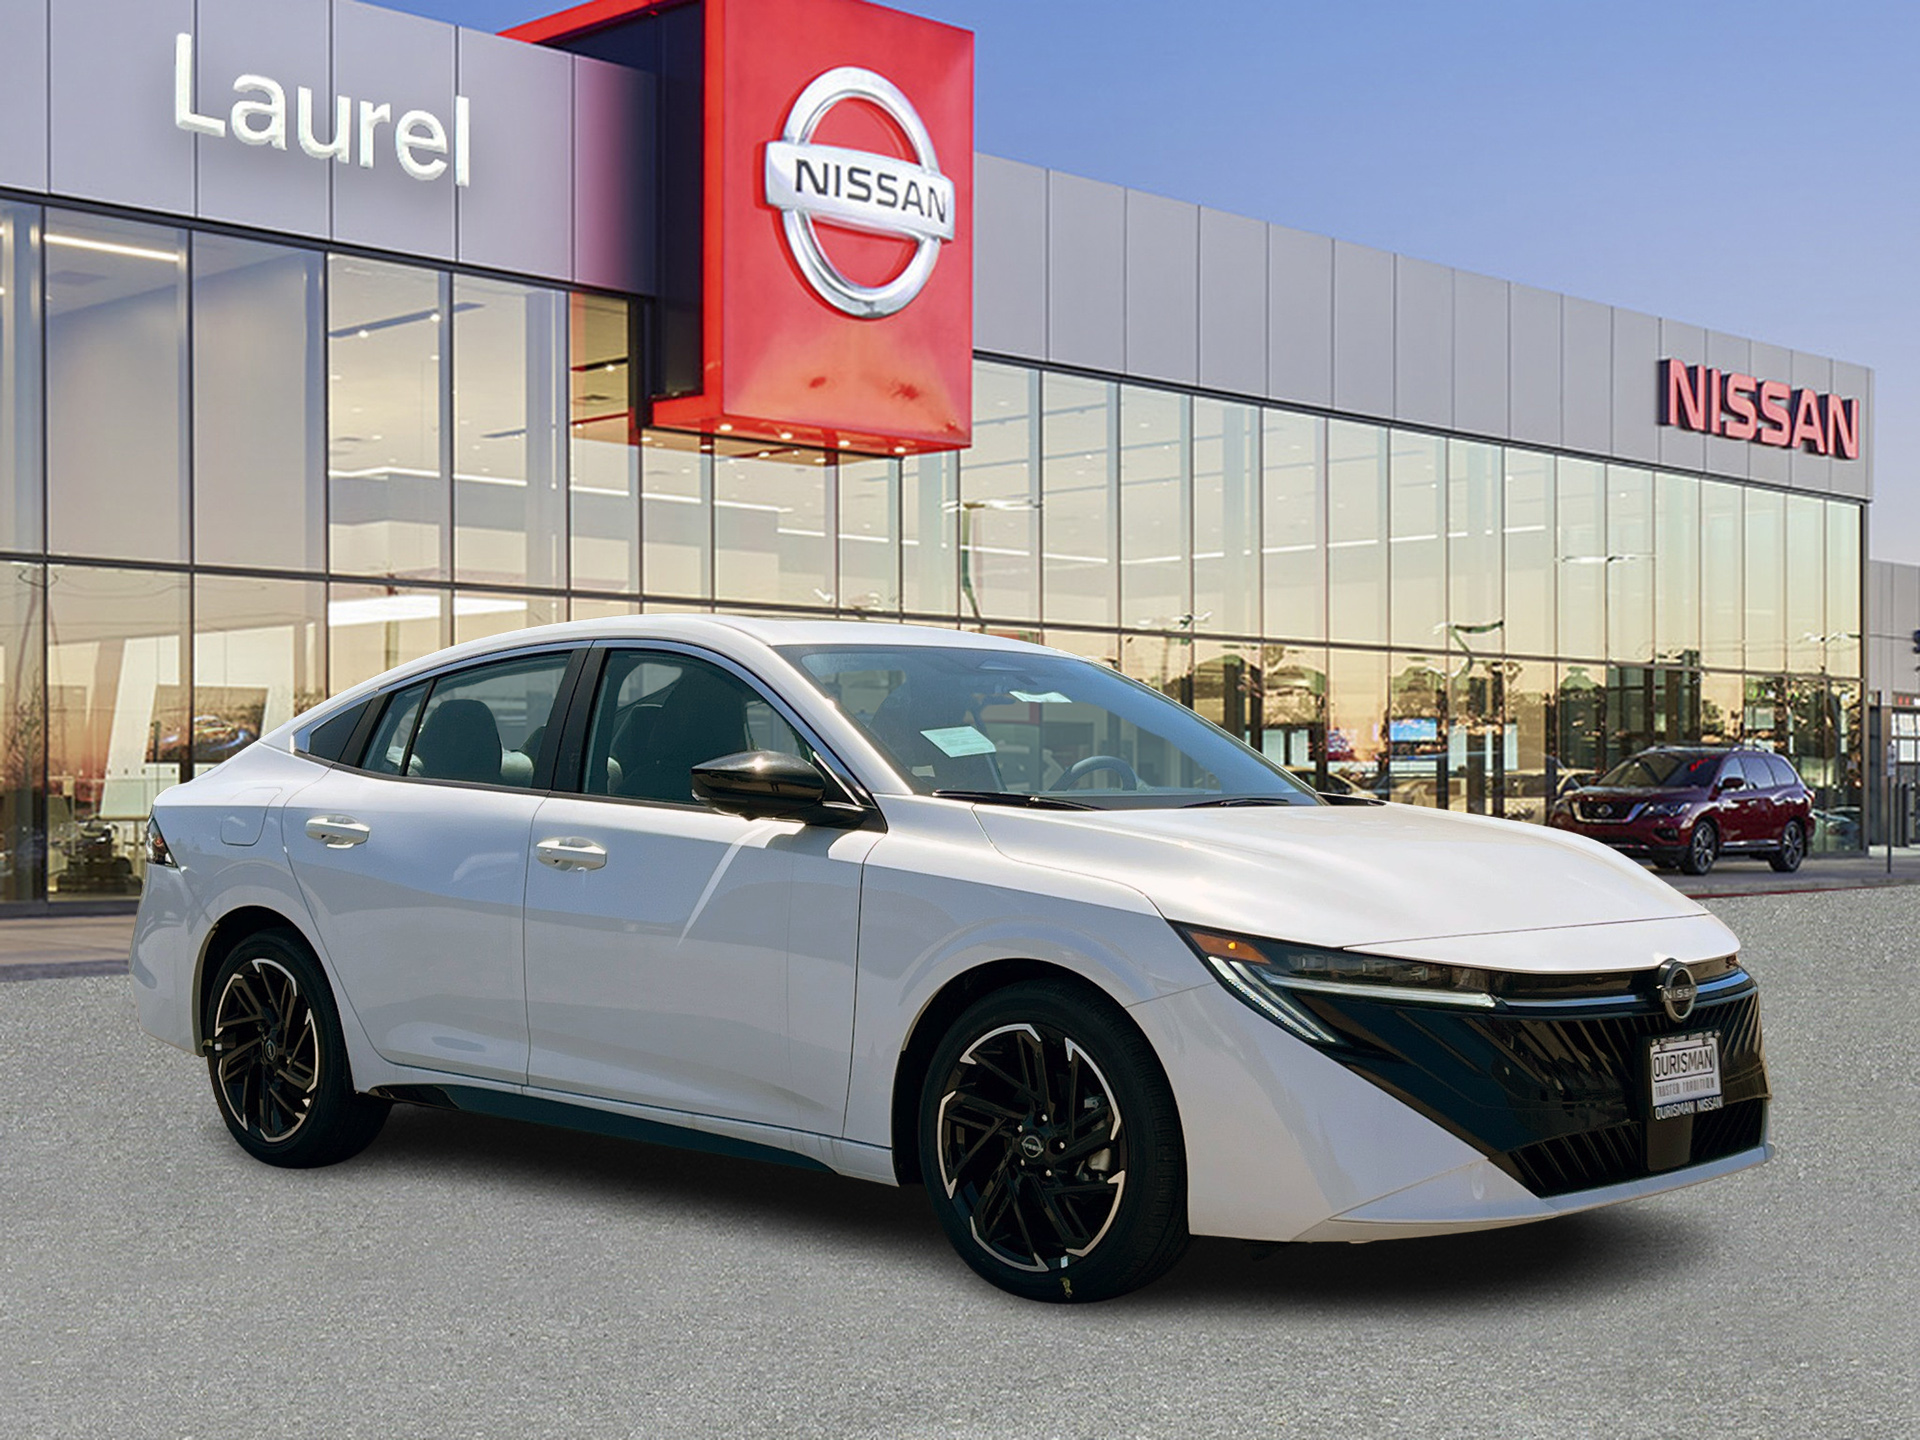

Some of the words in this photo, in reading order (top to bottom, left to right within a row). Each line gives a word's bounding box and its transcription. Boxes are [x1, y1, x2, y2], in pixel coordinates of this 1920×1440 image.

[175, 33, 469, 187] Laurel
[795, 158, 946, 223] NISSAN
[1658, 358, 1859, 459] NISSAN
[1653, 1049, 1713, 1077] OURISMAN
[1655, 1101, 1696, 1120] OURISMAN
[1697, 1095, 1723, 1112] NISSAN
